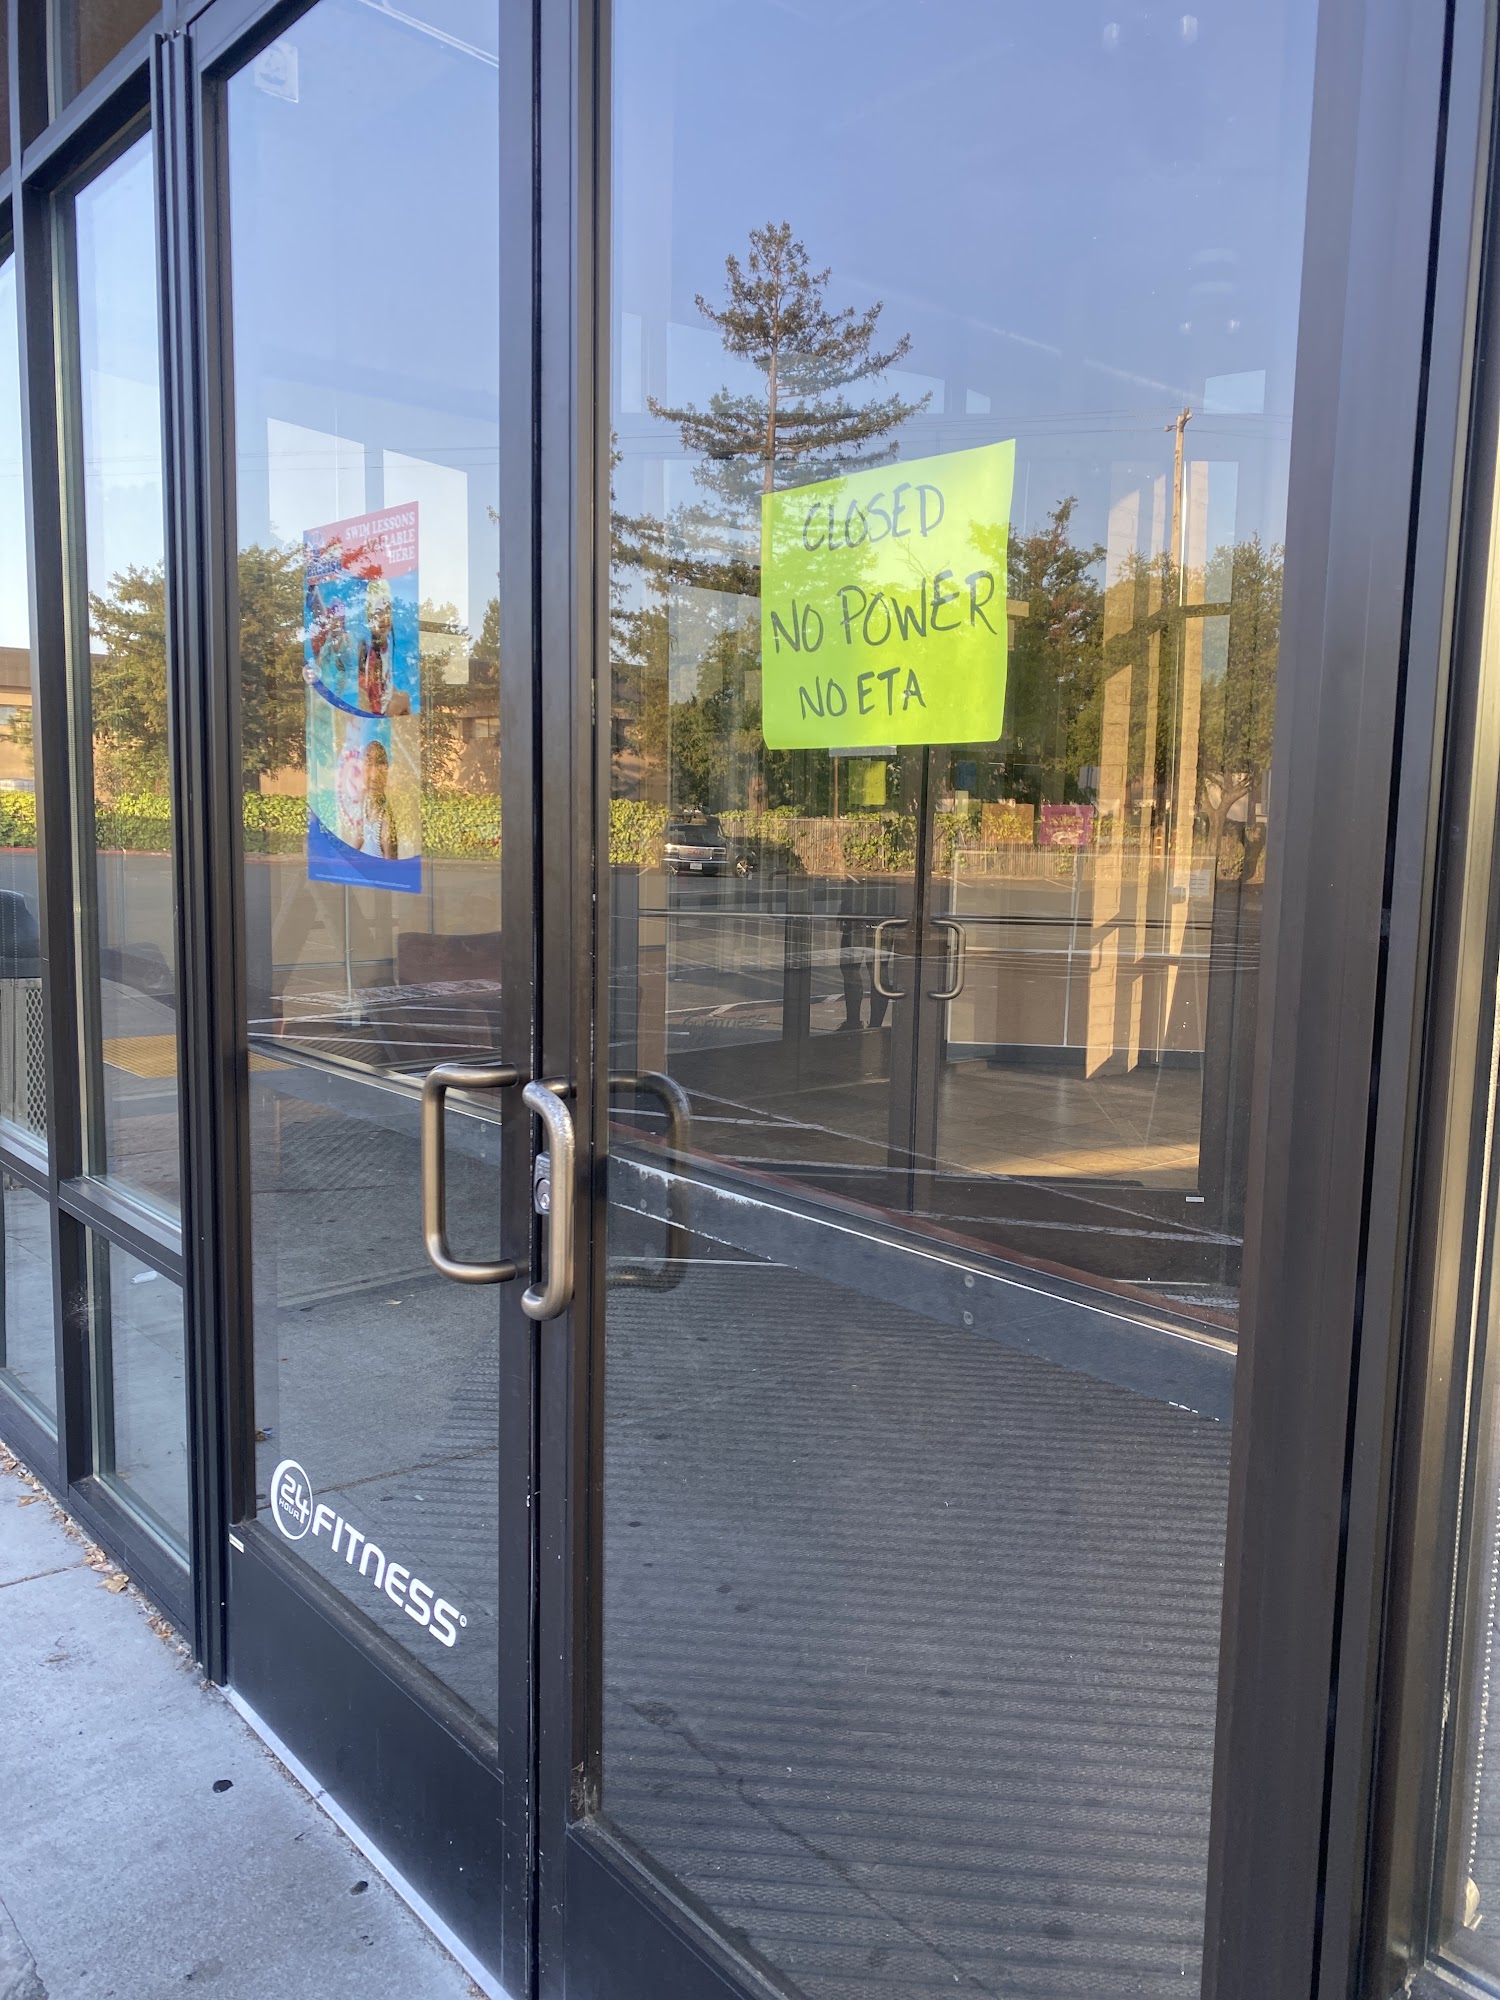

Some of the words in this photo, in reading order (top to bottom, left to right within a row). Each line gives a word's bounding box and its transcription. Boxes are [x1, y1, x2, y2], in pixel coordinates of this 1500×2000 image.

[345, 522, 371, 540] SWIM
[372, 512, 415, 534] LESSONS
[802, 482, 945, 552] CLOSED
[389, 546, 415, 564] HERE
[770, 599, 824, 654] NO
[836, 569, 998, 647] POWER
[798, 676, 848, 721] NO
[857, 667, 927, 716] ETA
[278, 1499, 300, 1520] HOUR
[280, 1473, 310, 1524] 24
